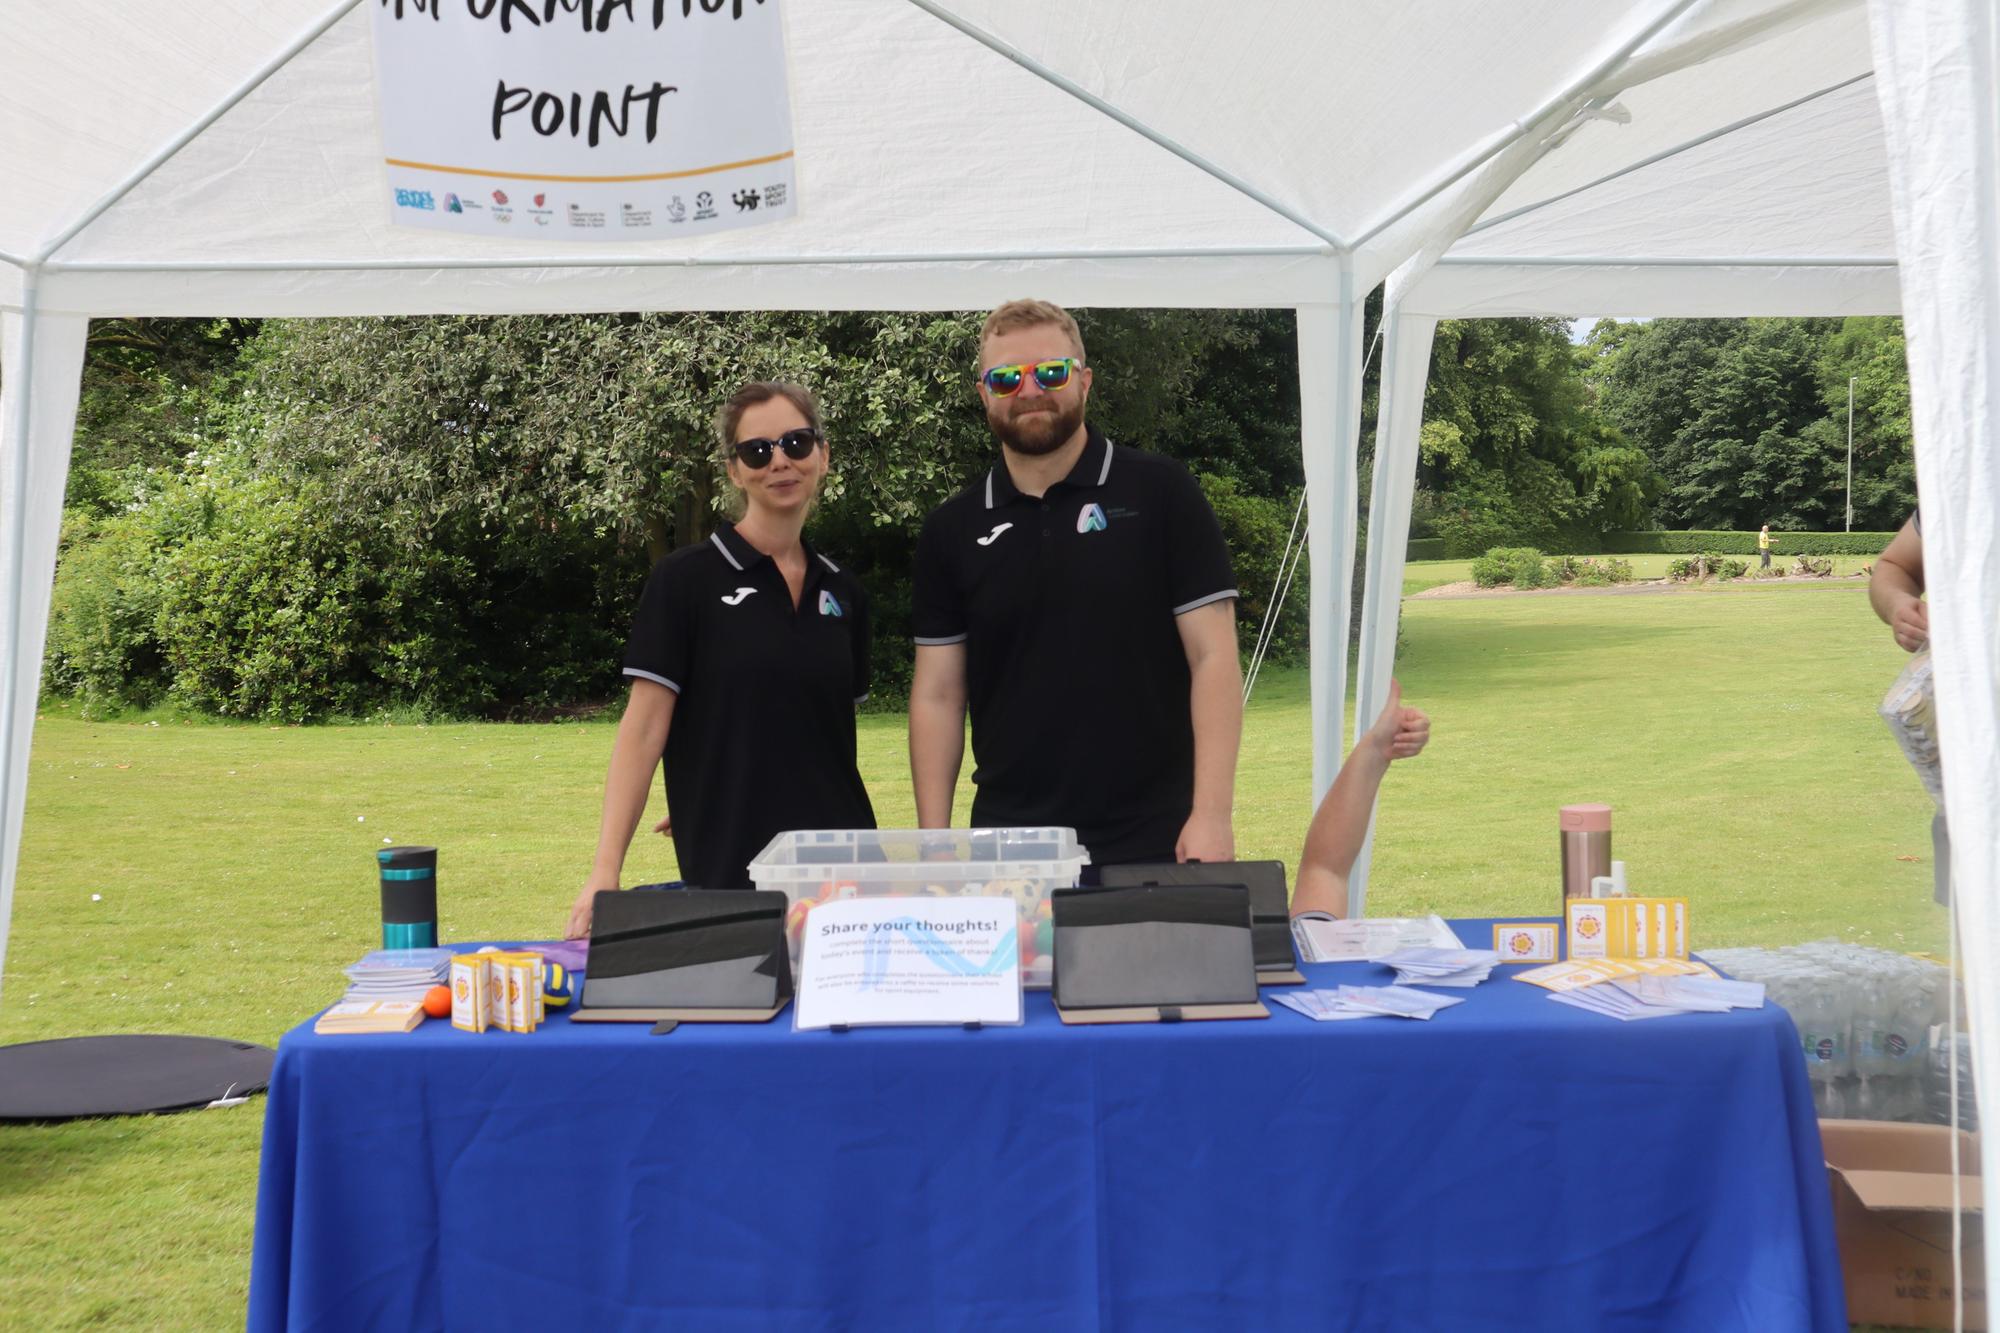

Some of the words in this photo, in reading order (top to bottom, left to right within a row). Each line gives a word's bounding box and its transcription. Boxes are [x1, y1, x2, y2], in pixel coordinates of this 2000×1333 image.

[492, 79, 678, 148] POINT
[821, 922, 869, 937] Share
[873, 922, 912, 934] your
[916, 919, 998, 934] thoughts!
